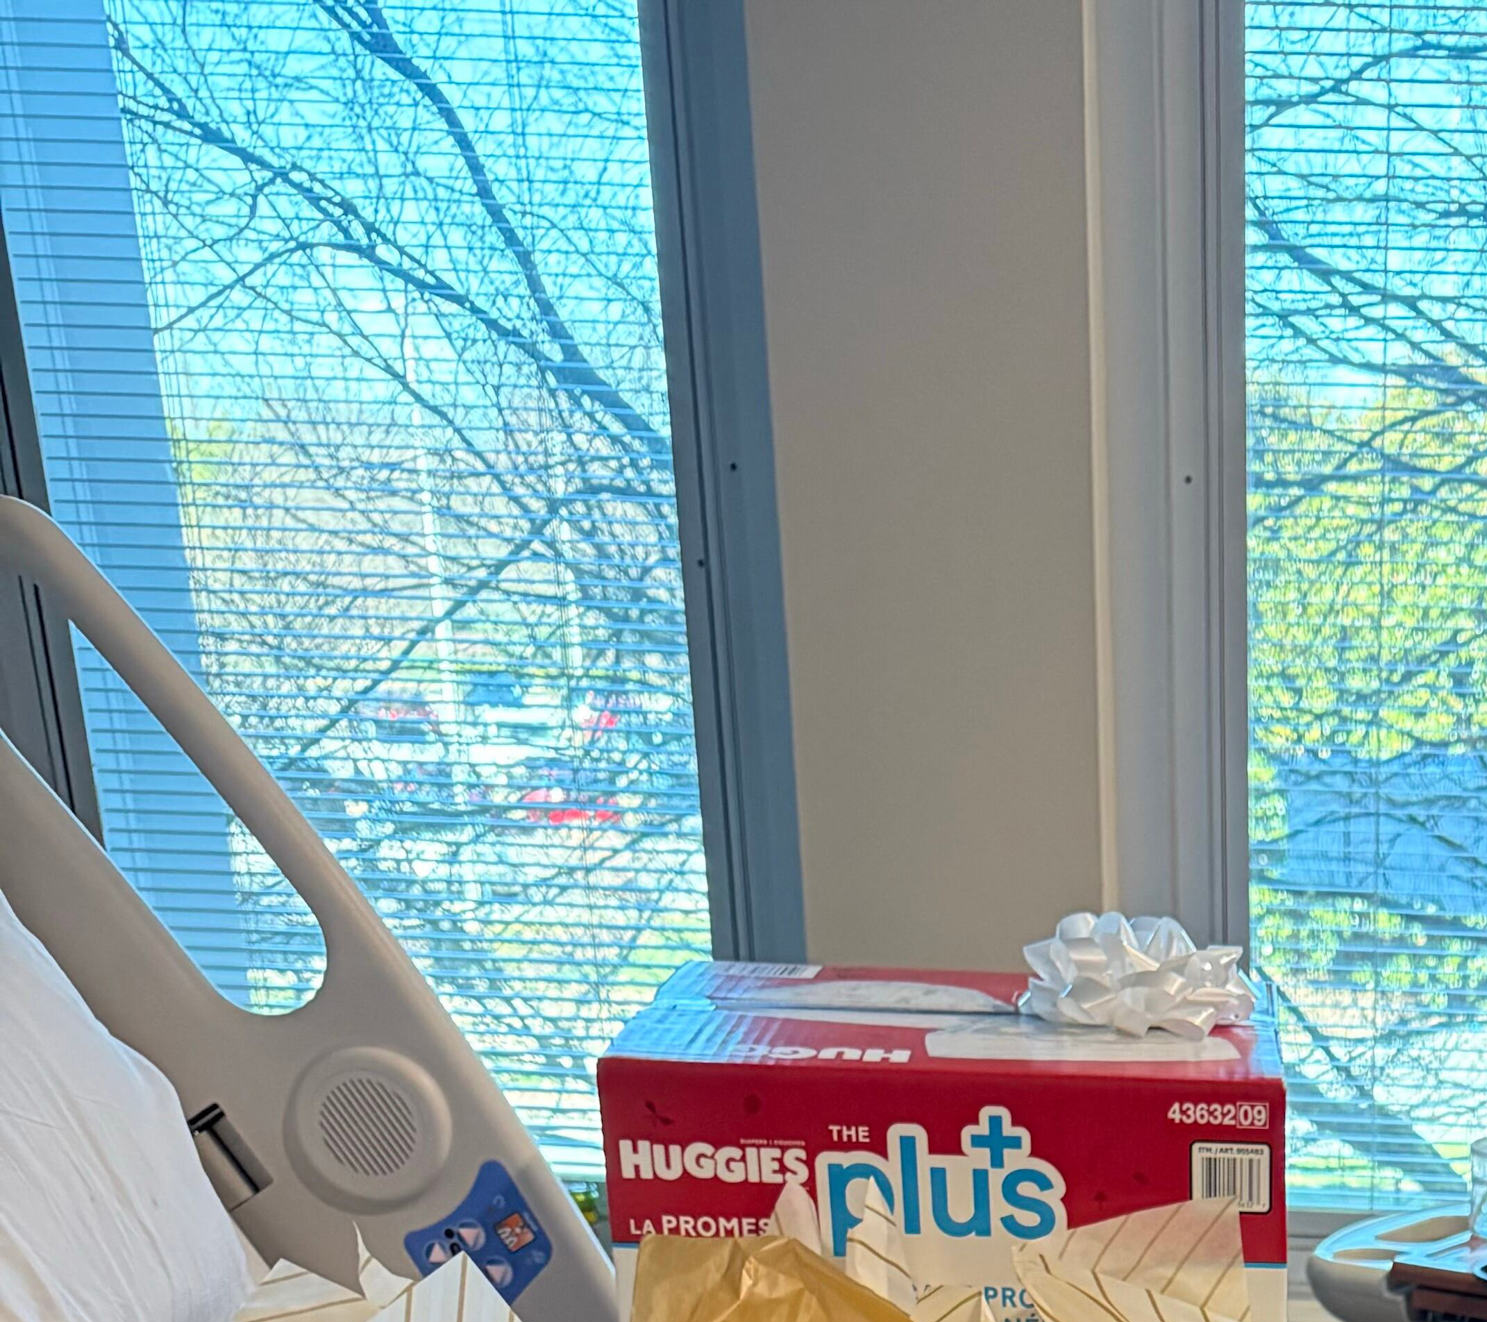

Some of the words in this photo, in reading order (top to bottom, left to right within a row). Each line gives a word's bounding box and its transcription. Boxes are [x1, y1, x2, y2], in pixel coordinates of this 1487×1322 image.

[828, 1125, 871, 1143] THE
[619, 1139, 810, 1184] HUGGIES
[629, 1218, 656, 1235] LA
[661, 1215, 771, 1237] PROMES
[984, 1286, 1035, 1309] PRO
